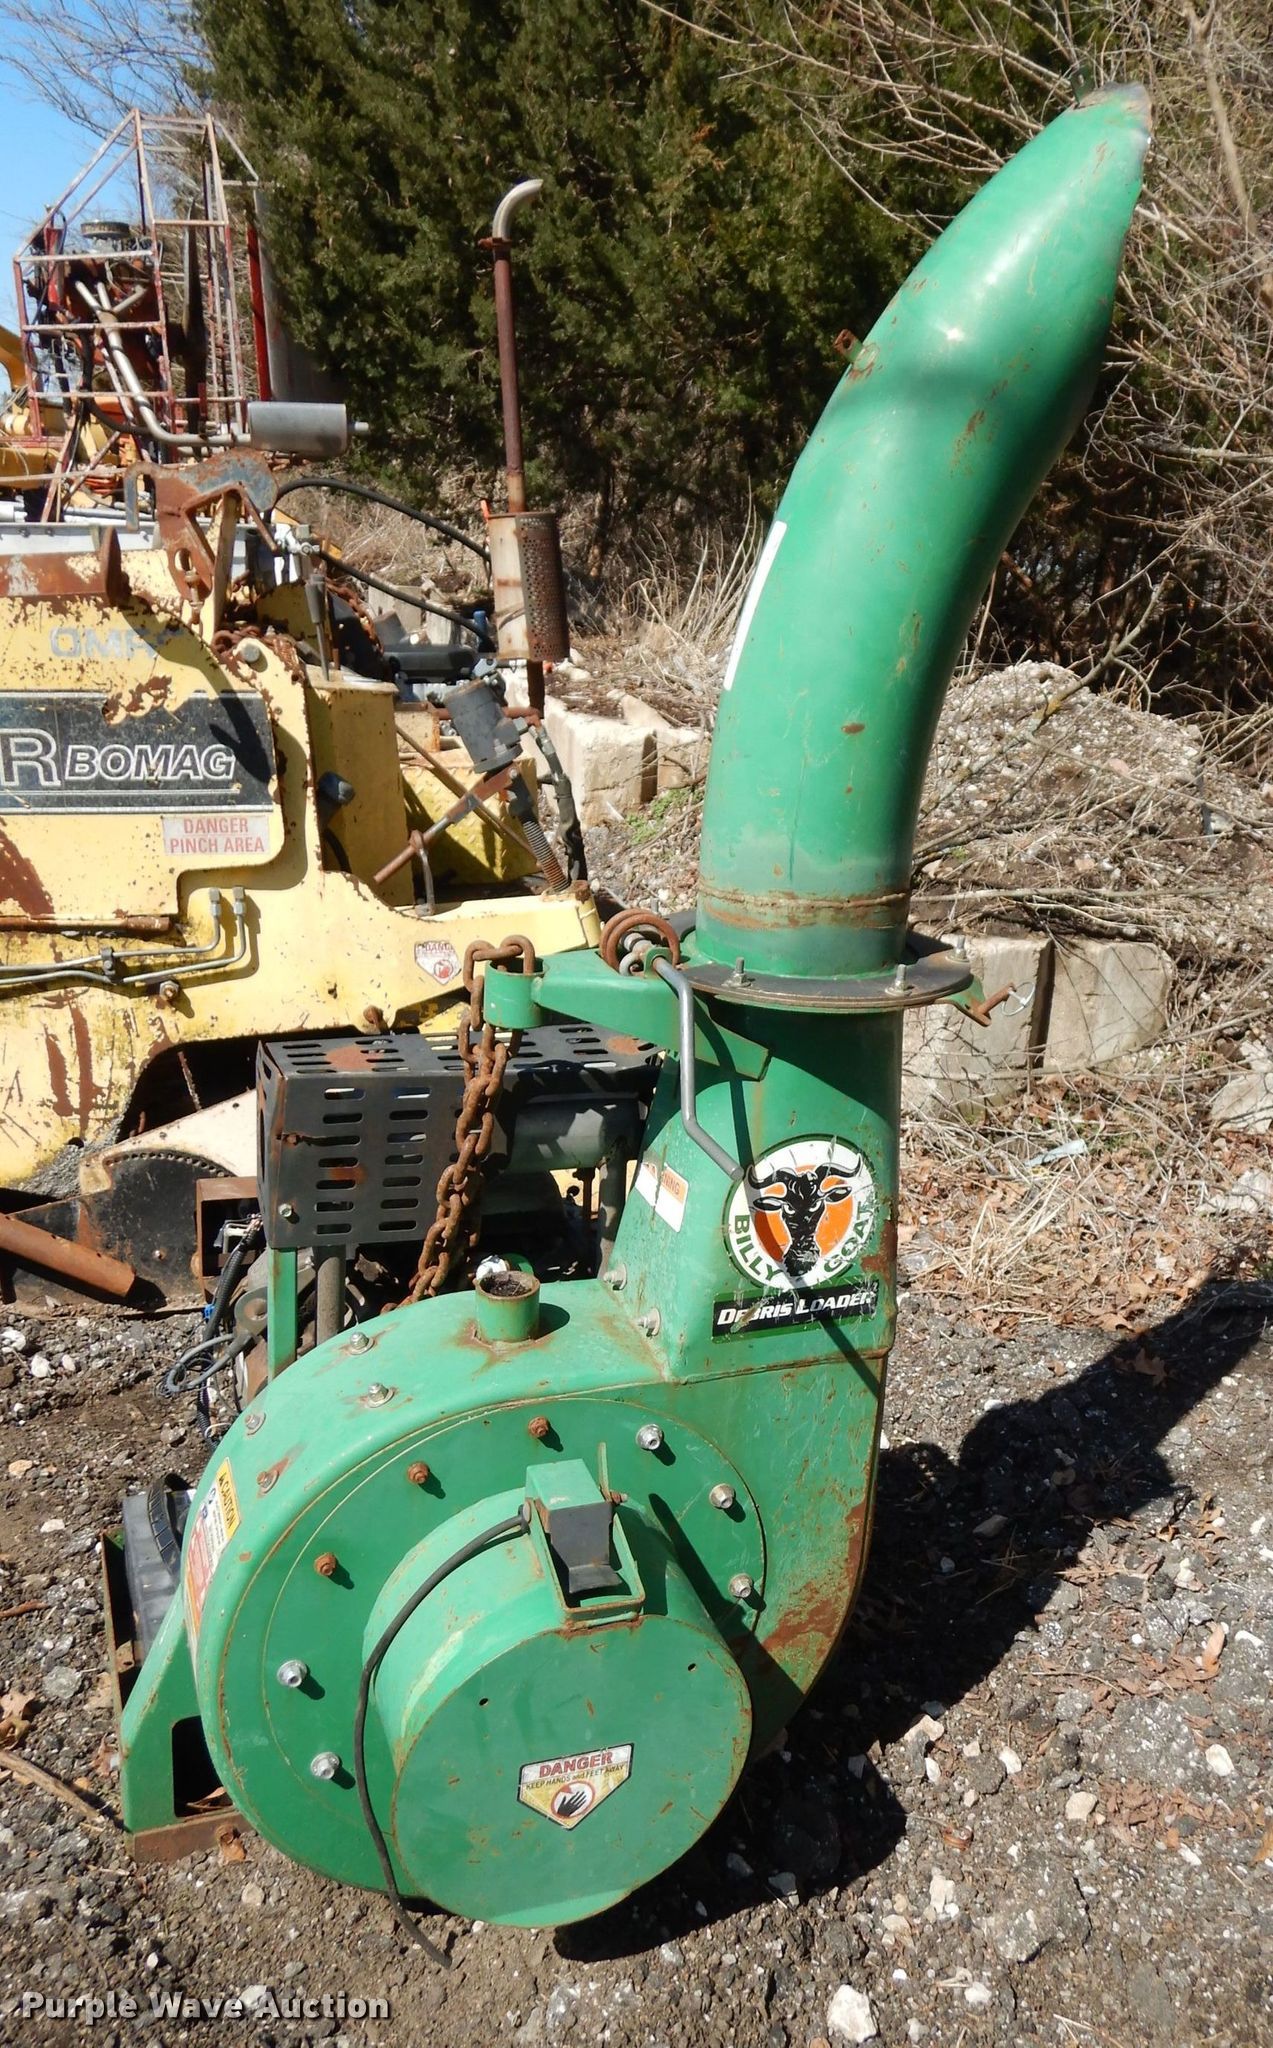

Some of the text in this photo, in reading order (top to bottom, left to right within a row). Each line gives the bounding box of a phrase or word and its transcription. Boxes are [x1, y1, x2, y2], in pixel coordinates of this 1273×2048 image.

[65, 744, 236, 781] BOMAG
[183, 817, 249, 834] DANGER
[169, 836, 265, 854] PINCH AREA
[734, 1201, 873, 1281] BILLY GOAT
[219, 1480, 236, 1530] CAUTION
[539, 1751, 613, 1778] DANGER
[525, 1781, 545, 1790] KEEP
[546, 1775, 571, 1786] HANDS
[585, 1768, 605, 1779] FEET
